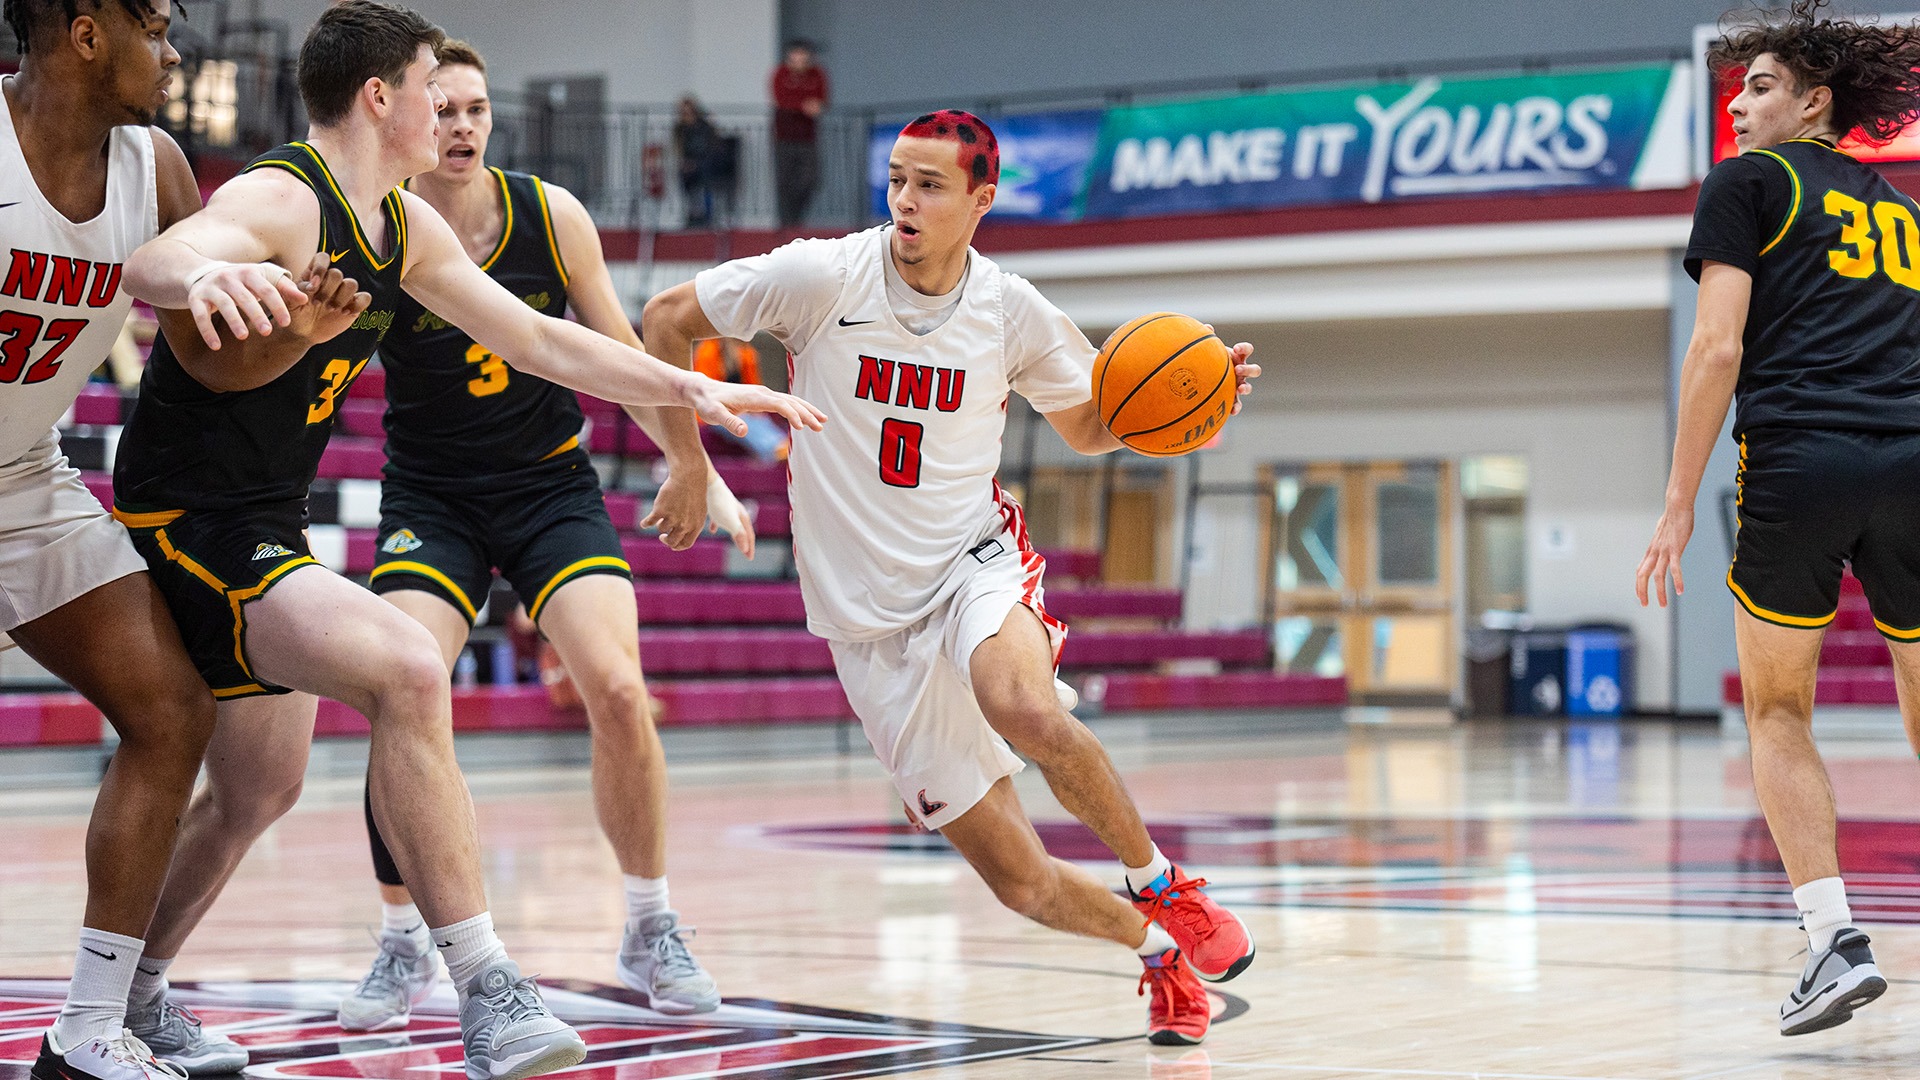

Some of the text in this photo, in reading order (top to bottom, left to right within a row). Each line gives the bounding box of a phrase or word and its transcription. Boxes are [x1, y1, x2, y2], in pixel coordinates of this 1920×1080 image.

[1110, 127, 1287, 192] MAKE
[1294, 123, 1358, 179] IT
[1355, 76, 1613, 202] YOURS
[1822, 188, 1920, 291] 30
[0, 248, 123, 308] NNU
[0, 310, 90, 385] 32
[465, 343, 510, 398] 3
[855, 354, 966, 412] NNU
[878, 417, 924, 488] 0
[1184, 400, 1226, 444] EVO
